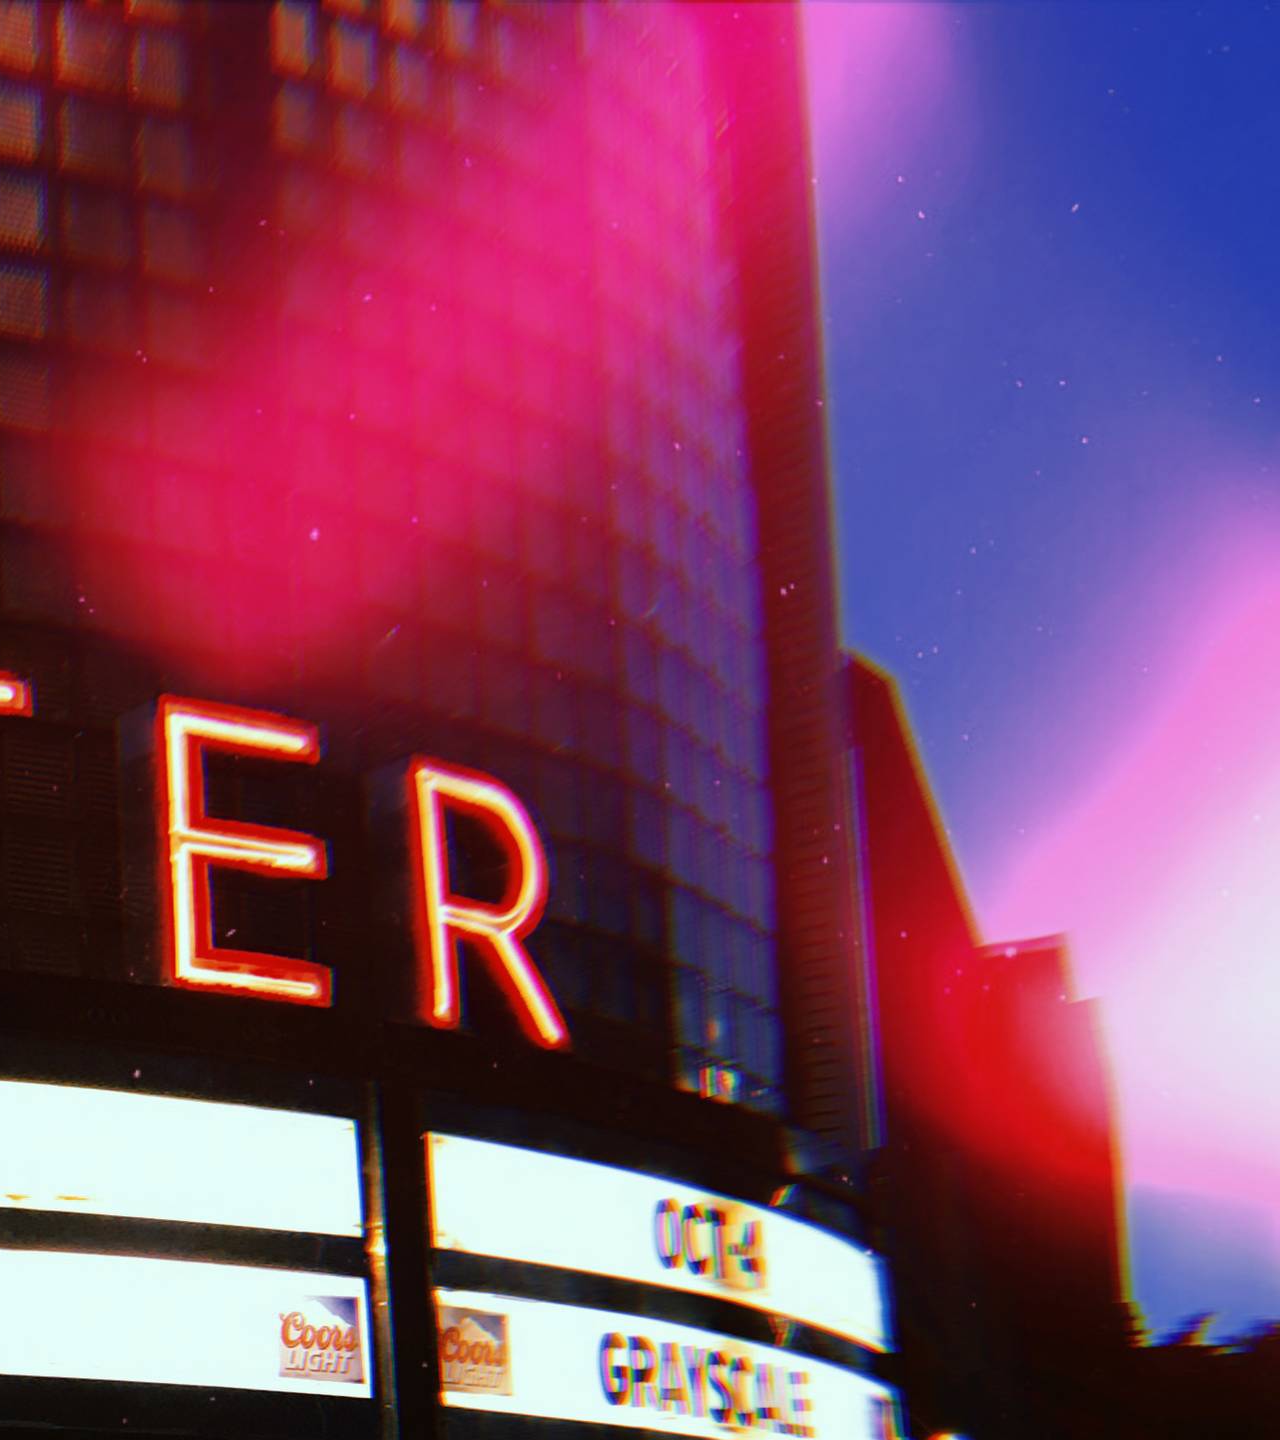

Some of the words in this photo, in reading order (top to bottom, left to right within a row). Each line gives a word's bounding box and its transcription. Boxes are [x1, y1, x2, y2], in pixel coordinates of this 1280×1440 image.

[653, 1198, 768, 1290] OCT-4
[278, 1311, 357, 1352] Coors
[441, 1326, 508, 1366] Coors
[284, 1350, 356, 1375] LIGHT
[598, 1332, 816, 1439] GRAYSCALE
